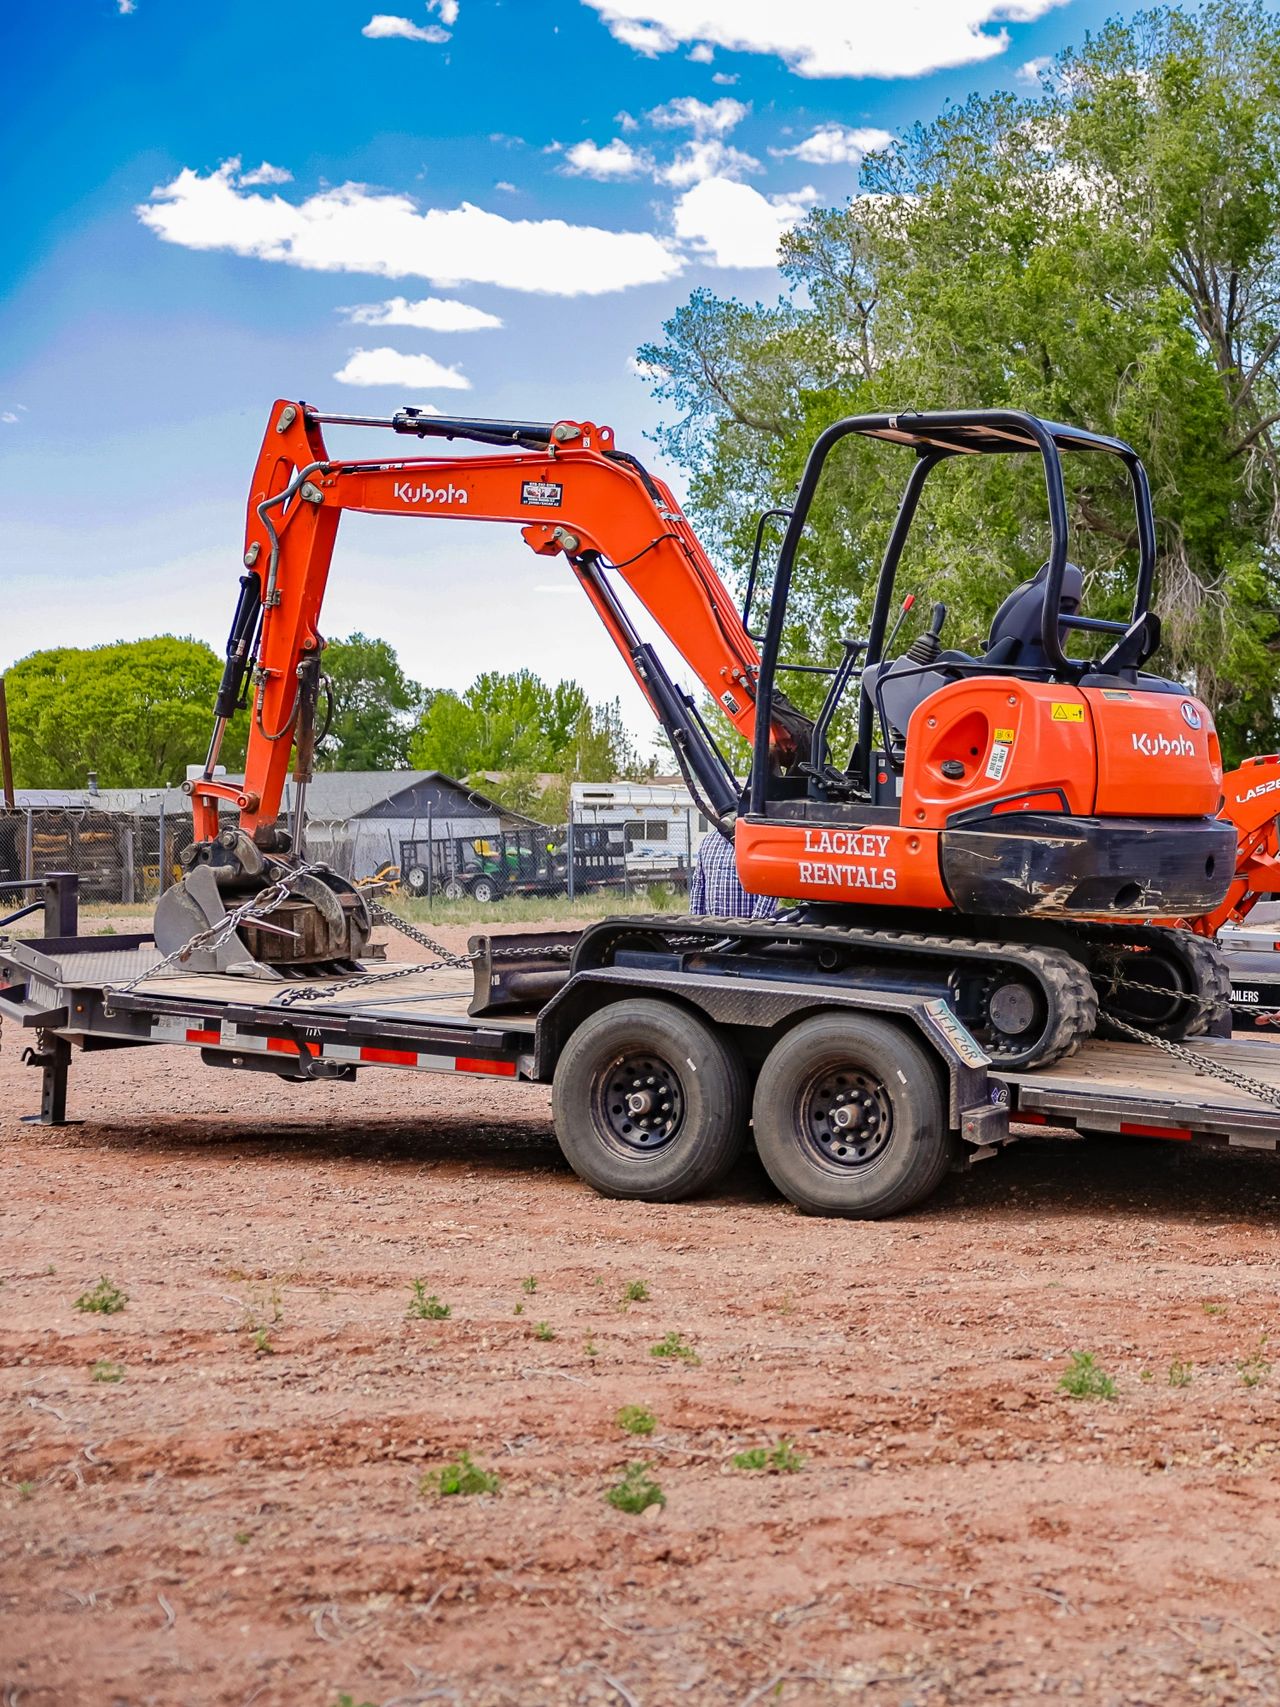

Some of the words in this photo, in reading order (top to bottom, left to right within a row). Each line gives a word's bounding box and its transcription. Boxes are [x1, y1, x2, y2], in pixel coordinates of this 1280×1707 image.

[394, 482, 468, 503] Kubota
[1132, 733, 1195, 756] Kubota
[989, 753, 999, 771] DIESEL
[804, 830, 890, 857] LACKEY
[799, 862, 897, 890] RENTALS
